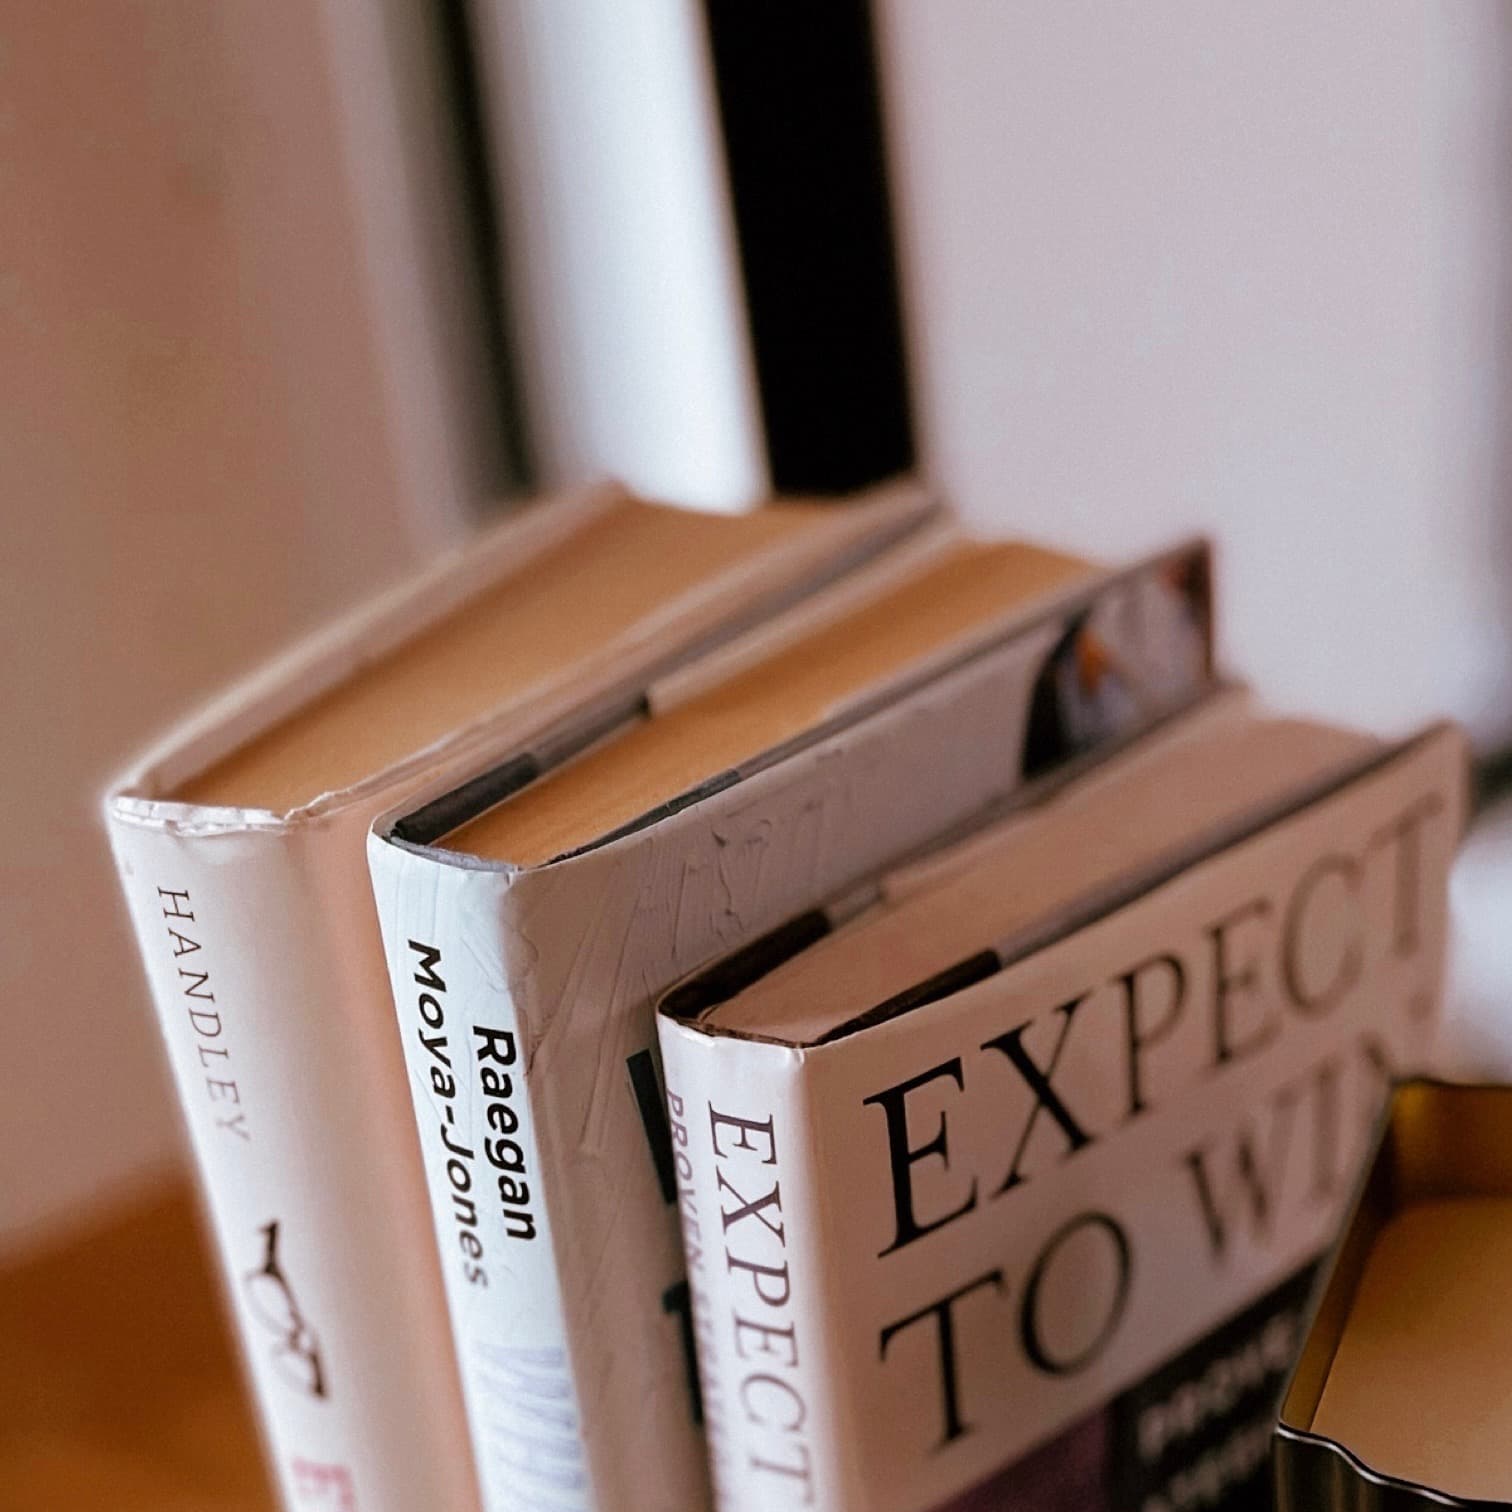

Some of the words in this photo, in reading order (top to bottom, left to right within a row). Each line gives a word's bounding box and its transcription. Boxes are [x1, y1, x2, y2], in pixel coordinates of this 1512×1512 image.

[157, 885, 249, 1142] HANDLEY
[407, 938, 488, 1289] Moya-Jones
[472, 1025, 537, 1241] Raegan
[862, 791, 1445, 1260] EXPECT
[707, 1099, 816, 1506] EXPECT
[880, 1211, 1131, 1453] TO
